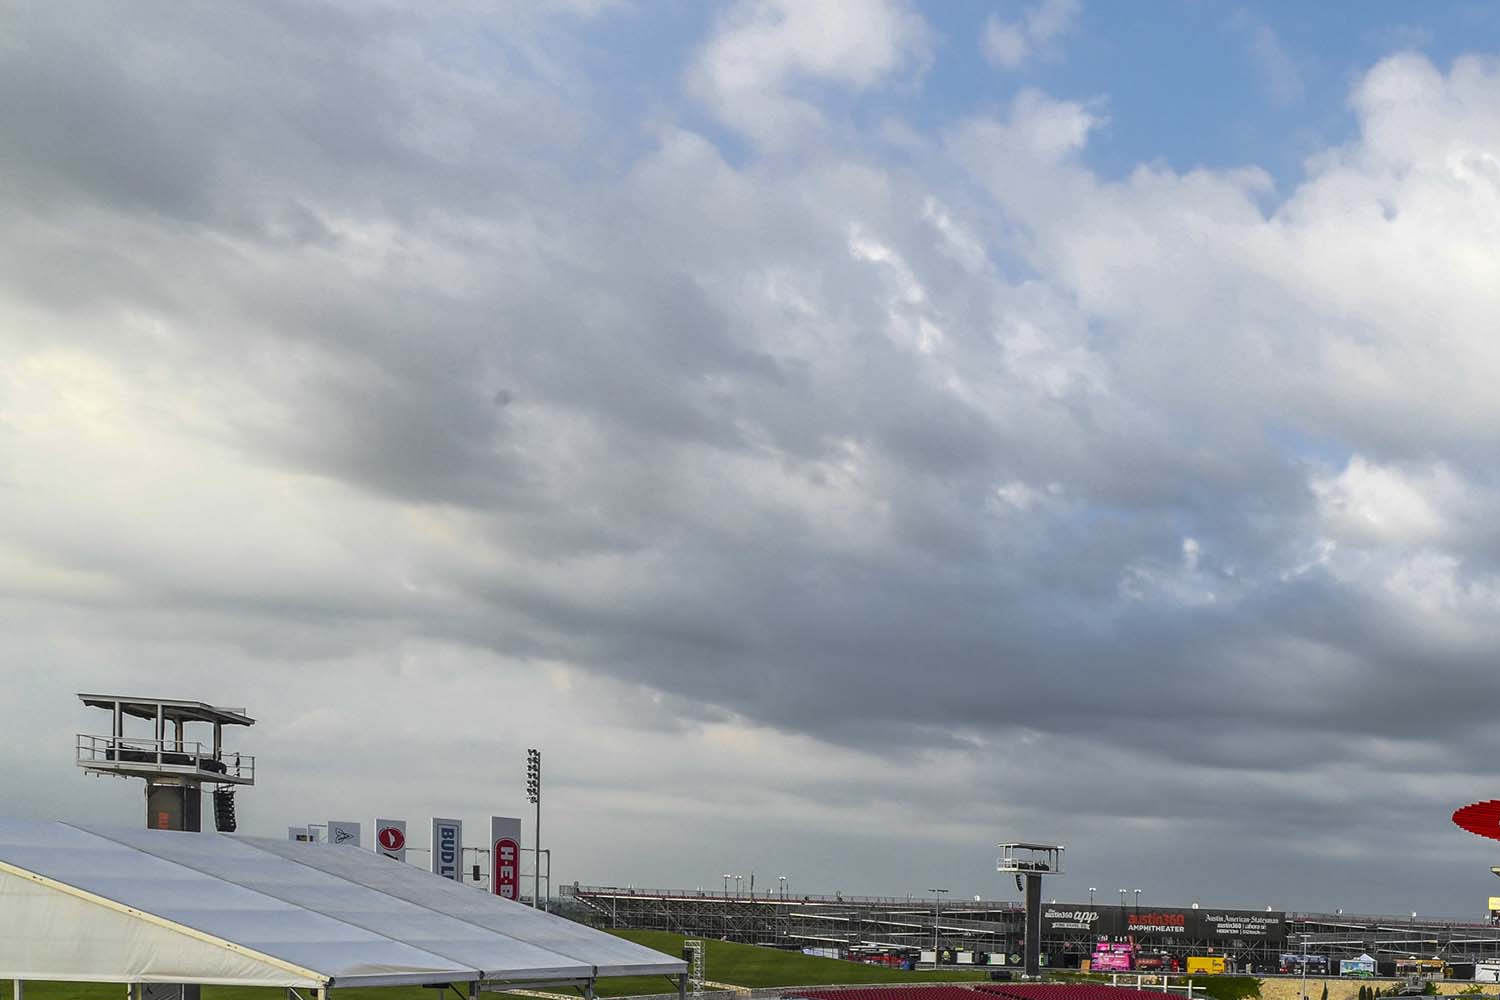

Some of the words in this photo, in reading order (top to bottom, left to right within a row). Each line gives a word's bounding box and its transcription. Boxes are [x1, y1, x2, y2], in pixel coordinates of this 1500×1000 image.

[441, 828, 454, 862] BUD
[1073, 911, 1100, 923] app
[1128, 913, 1184, 925] austin360
